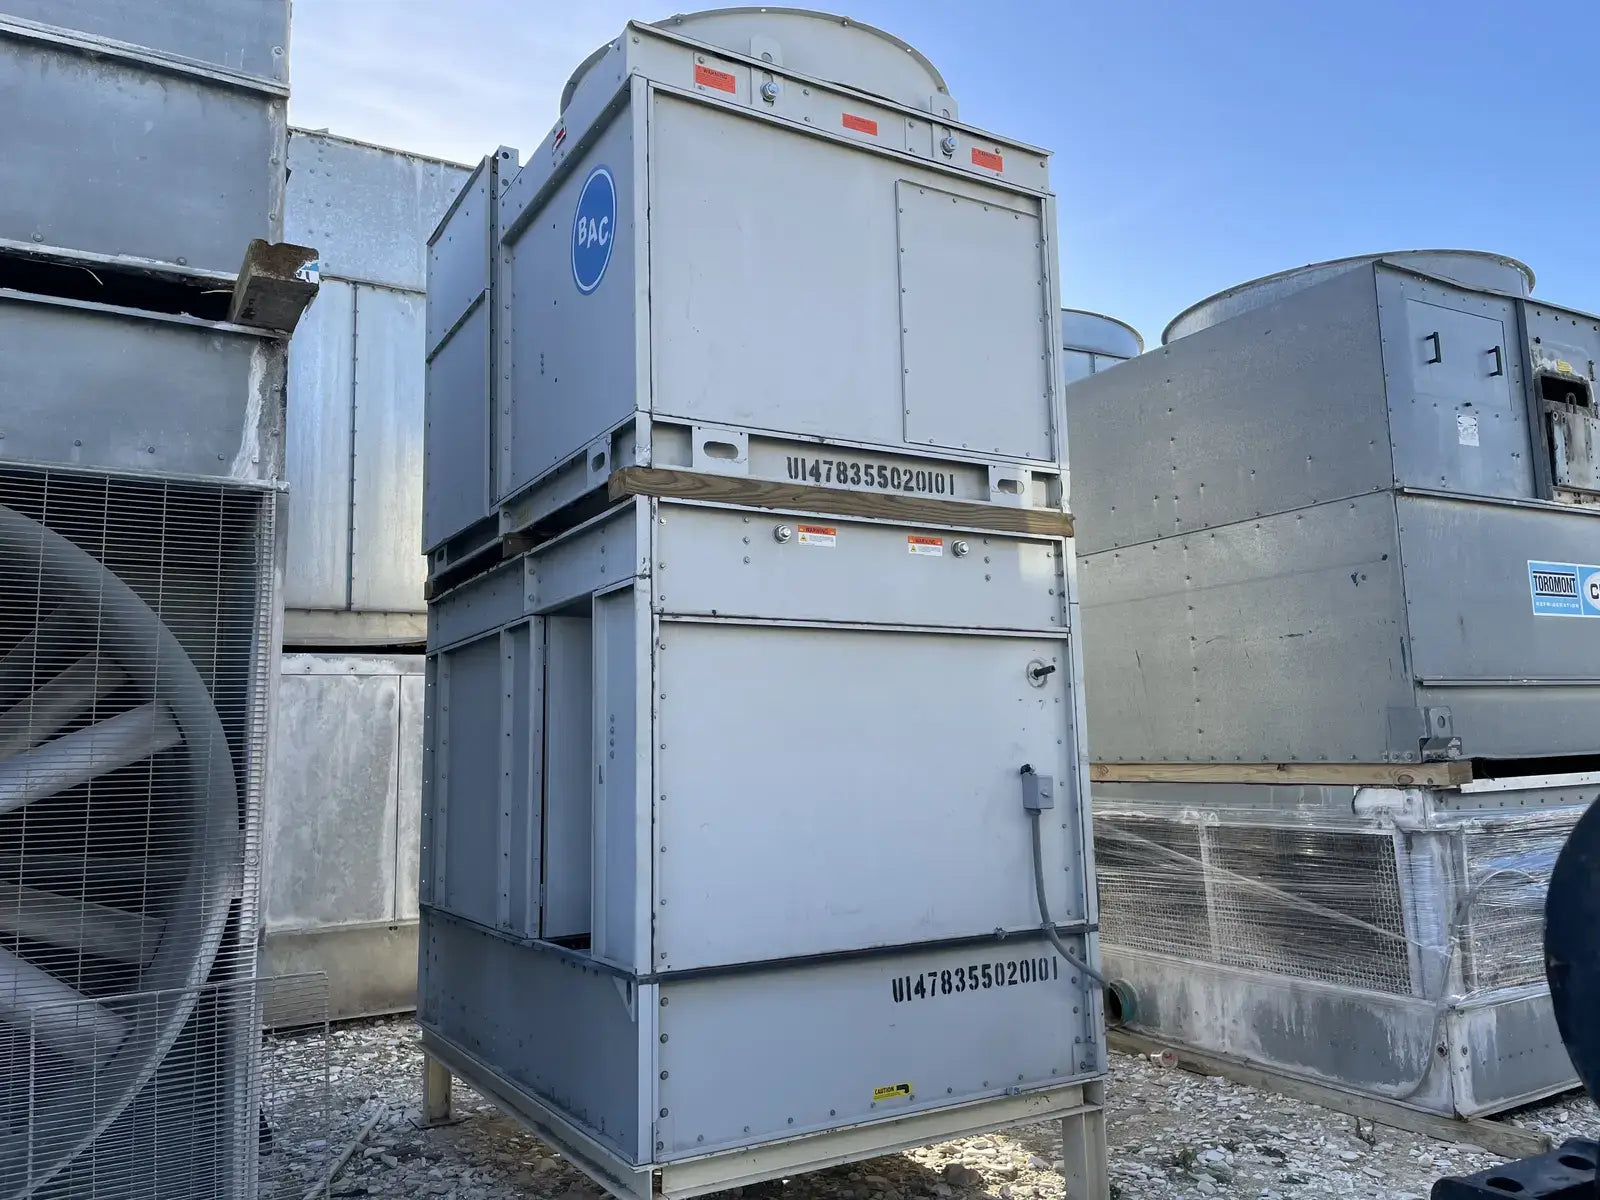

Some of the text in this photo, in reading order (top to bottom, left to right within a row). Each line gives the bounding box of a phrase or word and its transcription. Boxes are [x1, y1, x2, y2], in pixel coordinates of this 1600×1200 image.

[578, 216, 609, 248] BAC
[786, 456, 955, 496] U1478355020101
[1533, 575, 1576, 594] TOROMONT
[891, 955, 1058, 1003] U1478355020101
[874, 1086, 895, 1096] CAUTION
